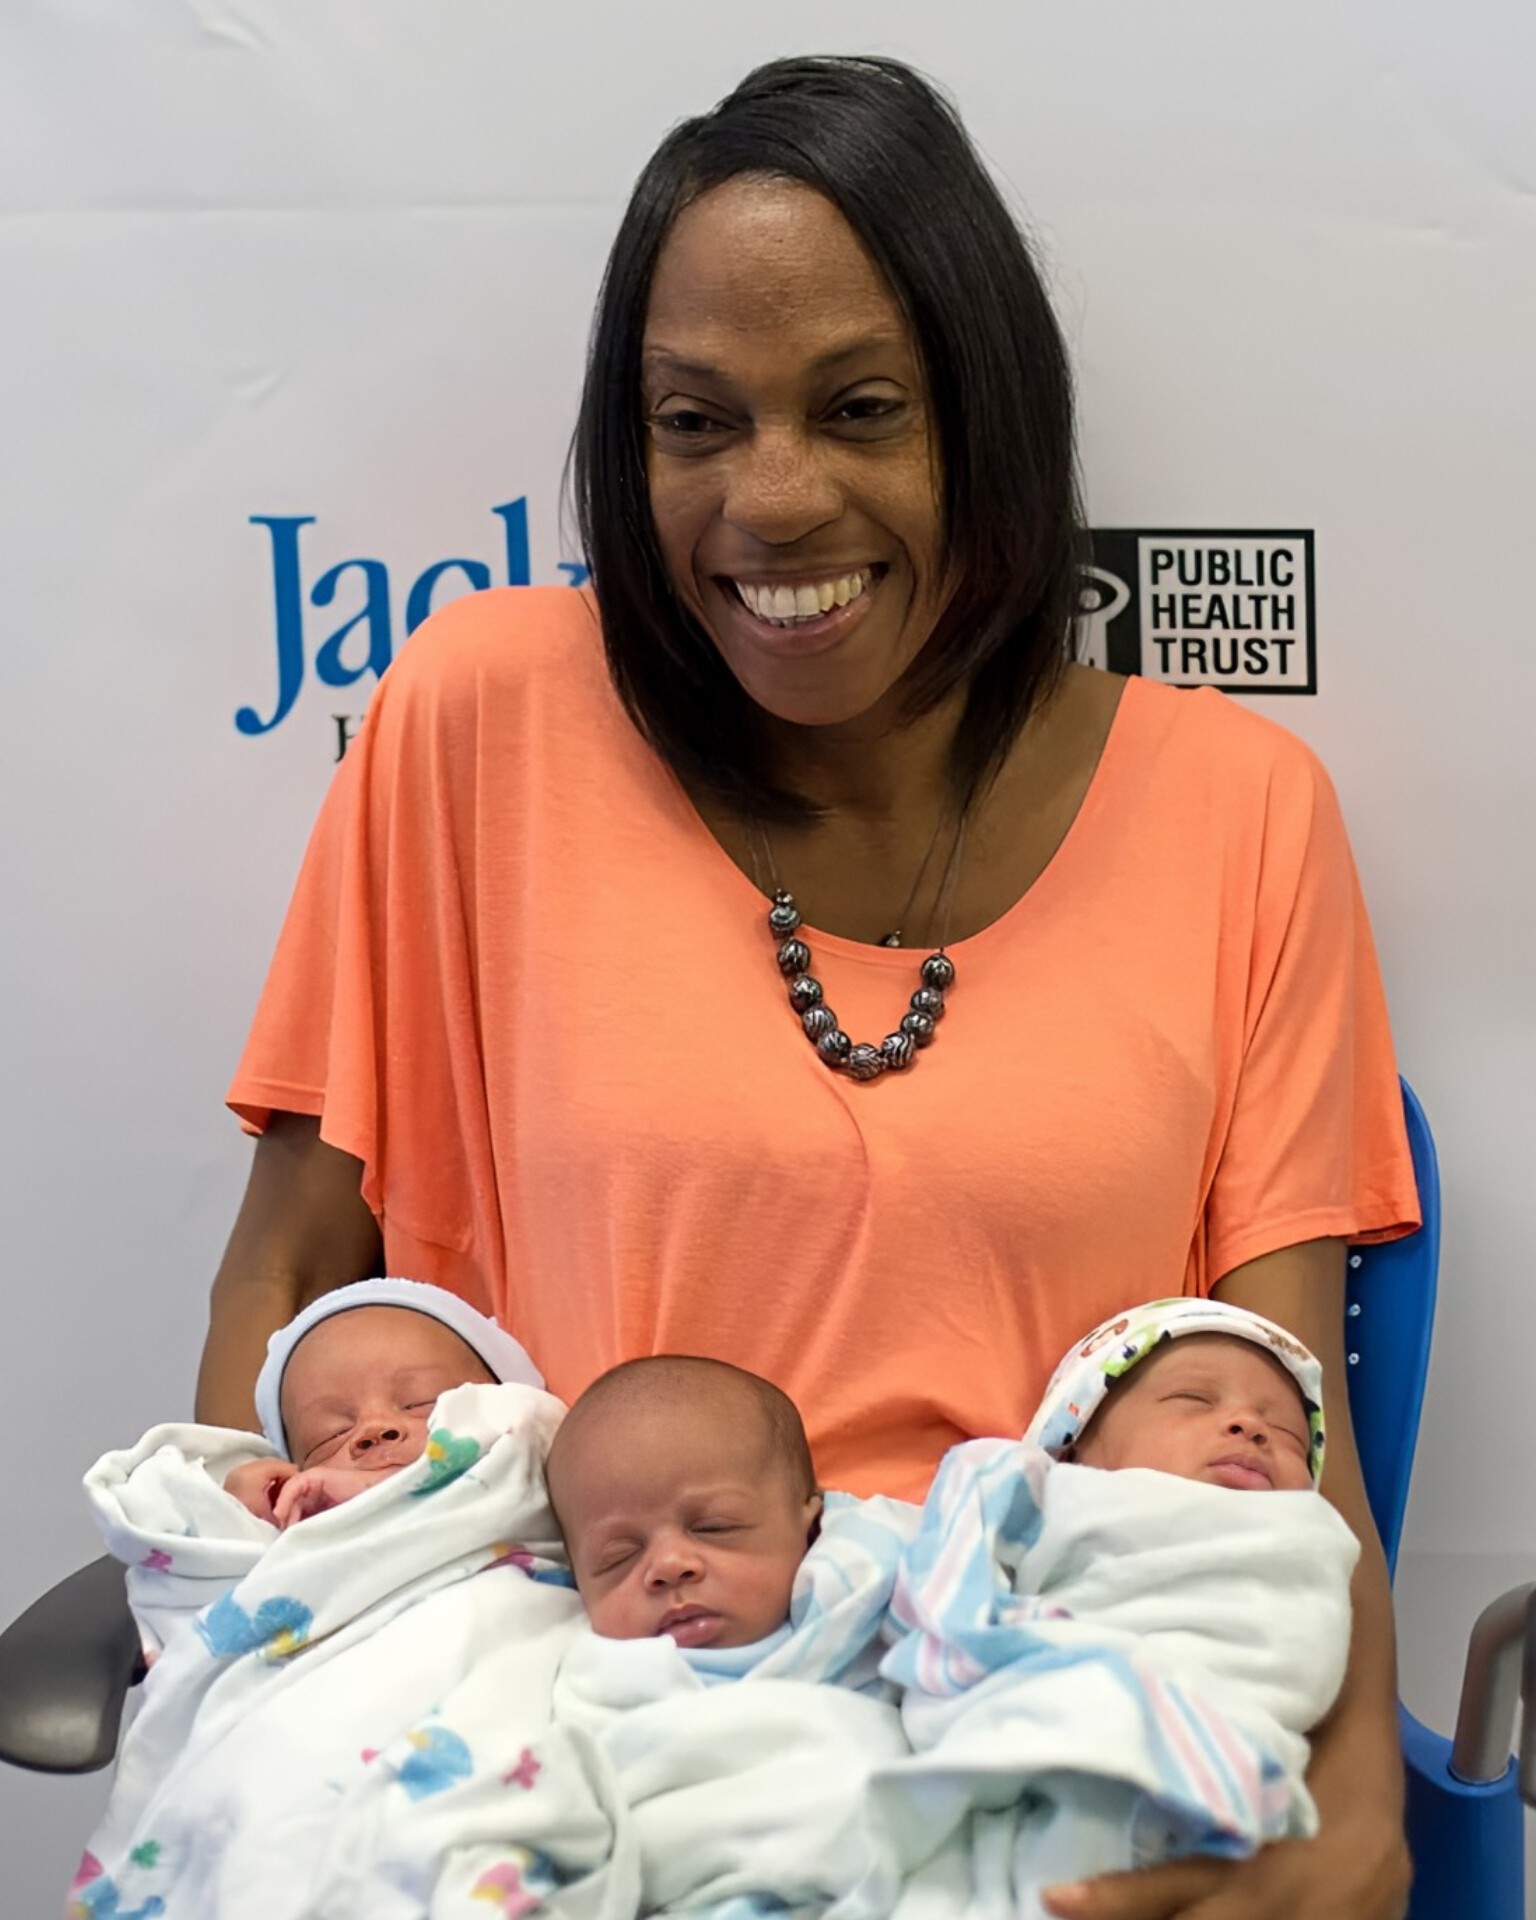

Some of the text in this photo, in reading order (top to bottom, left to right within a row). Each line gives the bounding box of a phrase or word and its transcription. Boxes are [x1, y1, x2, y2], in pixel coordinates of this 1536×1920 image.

[1151, 548, 1295, 587] PUBLIC
[1152, 593, 1296, 631] HEALTH
[1152, 637, 1296, 676] TRUST
